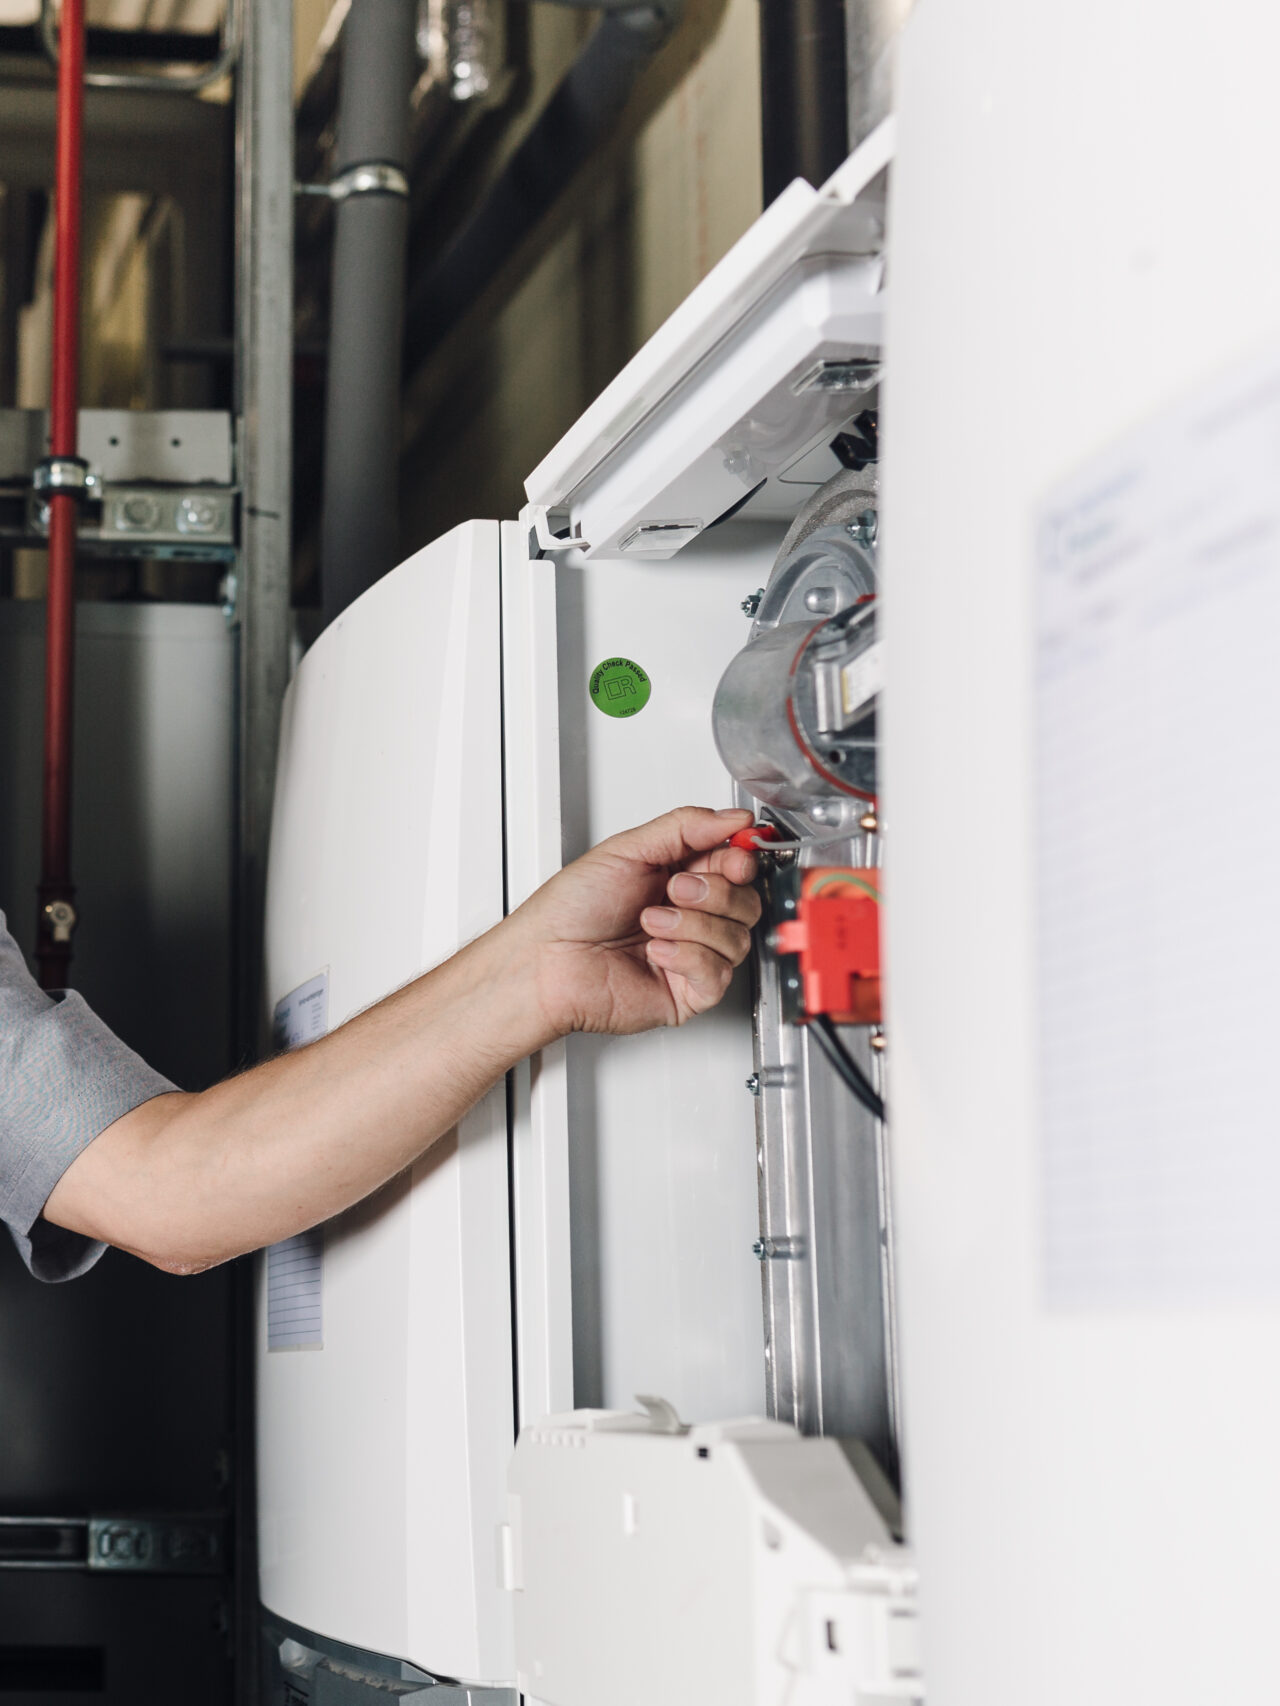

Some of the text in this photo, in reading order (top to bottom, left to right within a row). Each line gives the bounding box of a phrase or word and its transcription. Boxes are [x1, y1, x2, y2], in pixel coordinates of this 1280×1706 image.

[592, 659, 647, 694] Quality Check Passed
